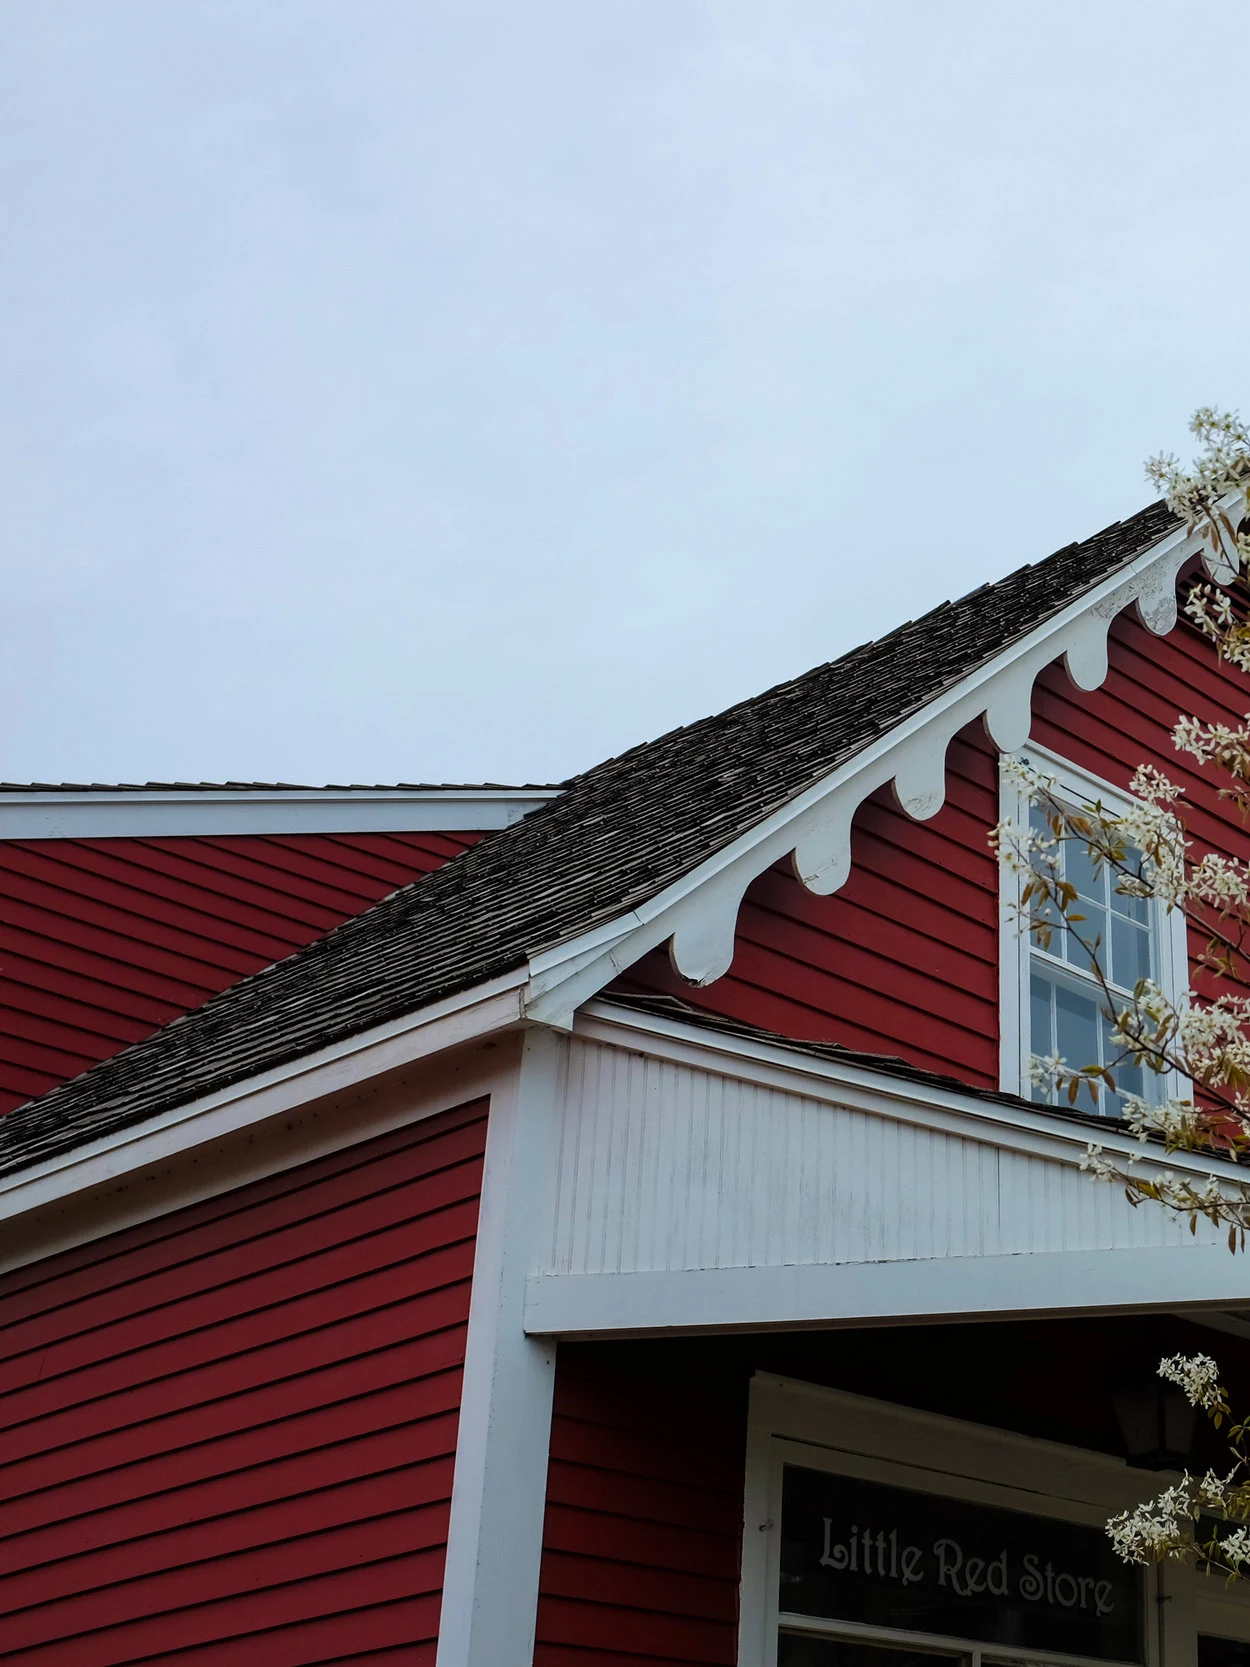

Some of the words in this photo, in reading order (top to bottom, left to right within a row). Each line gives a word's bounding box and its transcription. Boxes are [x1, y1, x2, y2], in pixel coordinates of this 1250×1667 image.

[819, 1517, 925, 1585] Little
[932, 1538, 1009, 1597] Red
[1019, 1554, 1115, 1617] Store
